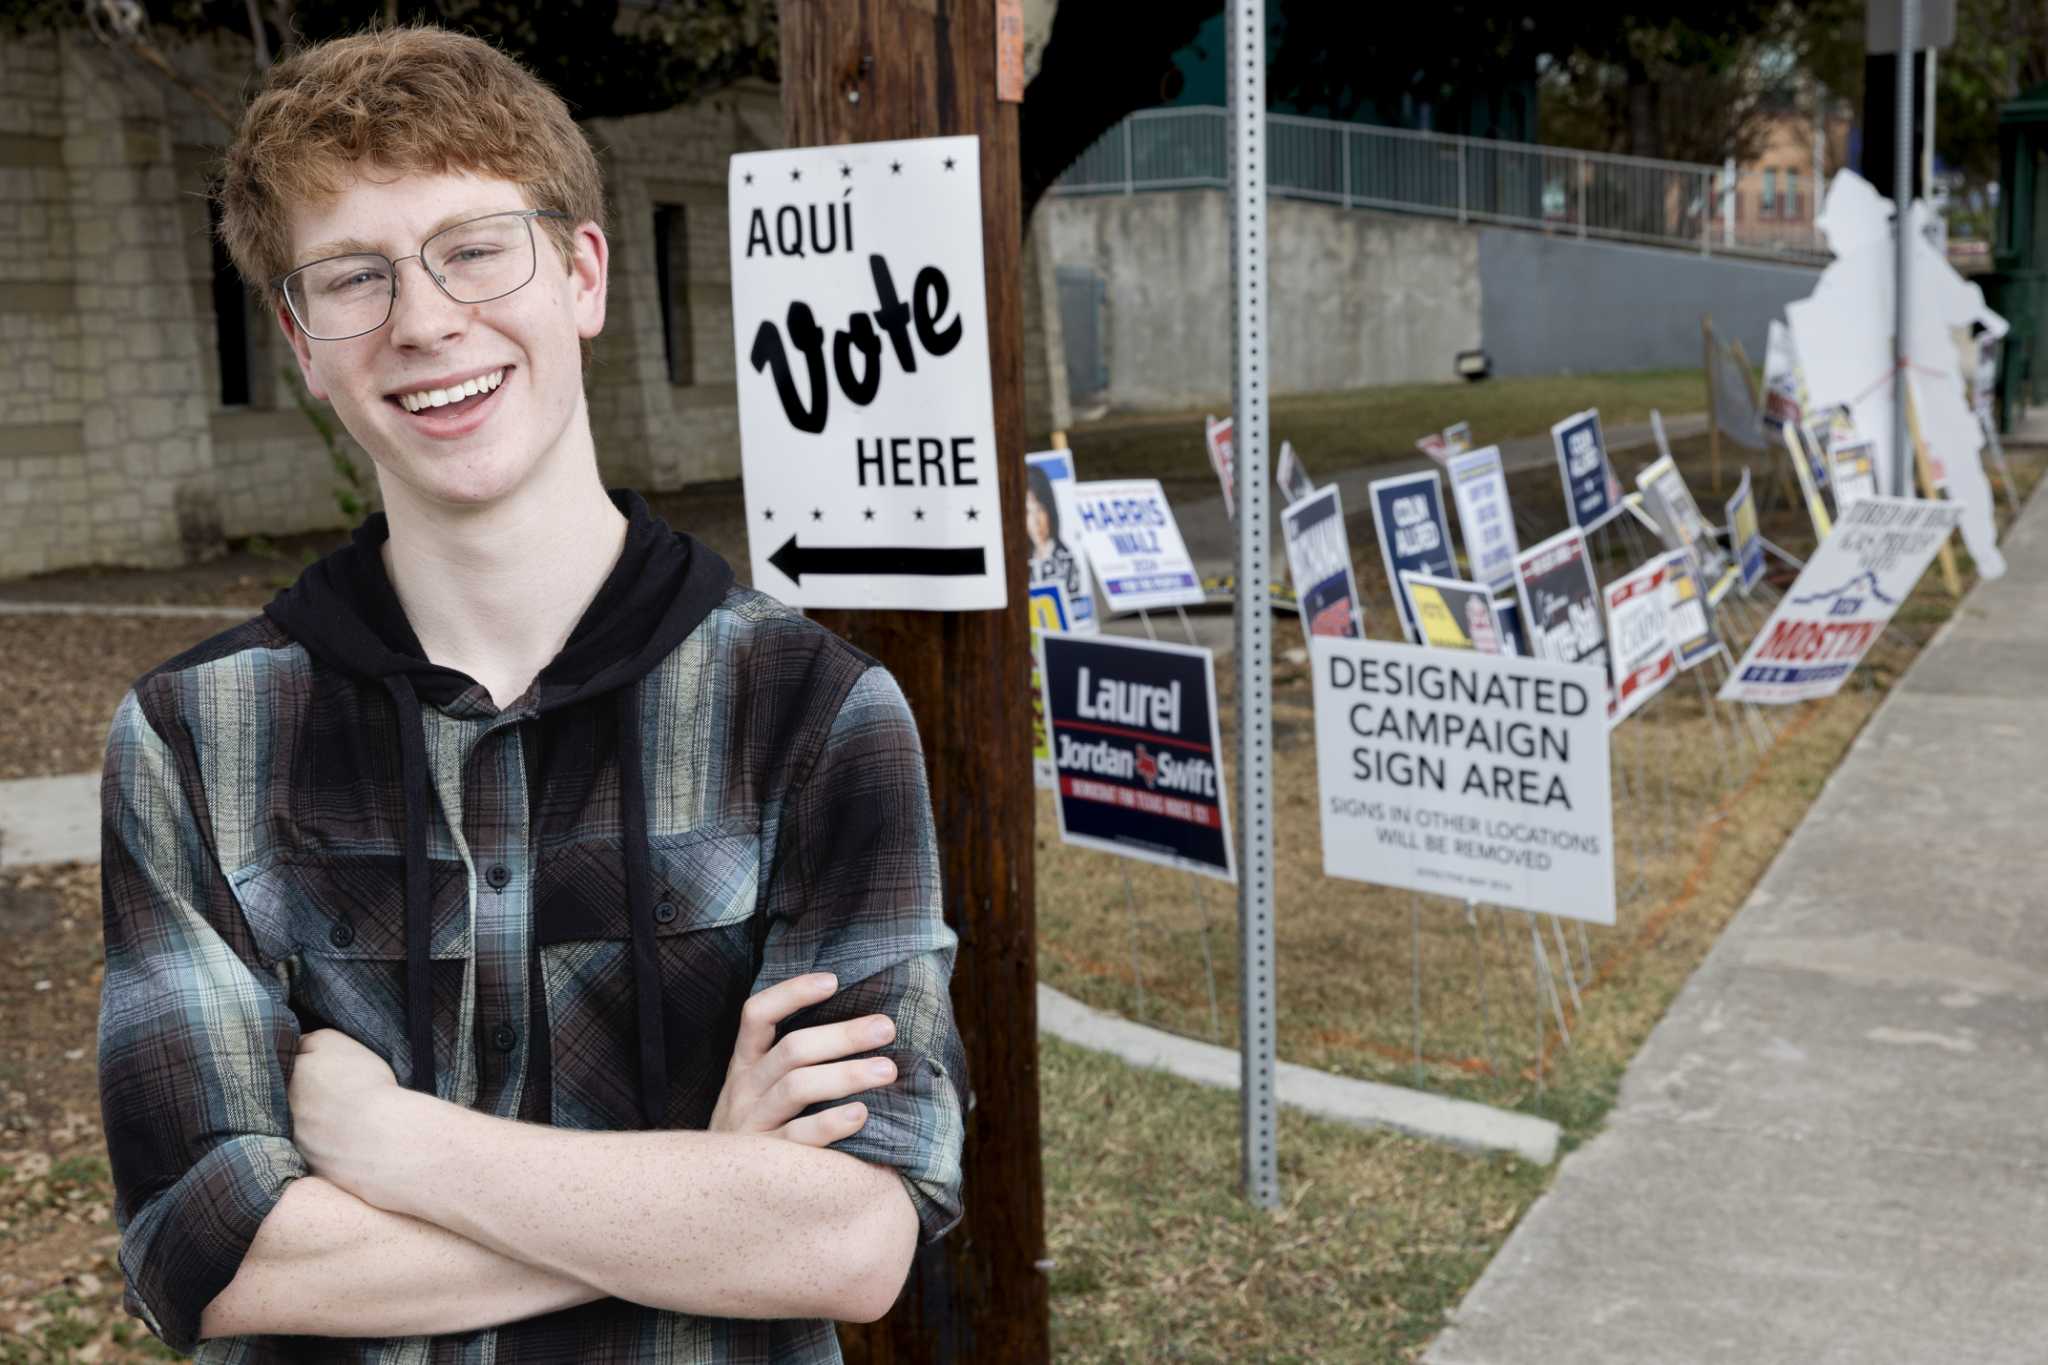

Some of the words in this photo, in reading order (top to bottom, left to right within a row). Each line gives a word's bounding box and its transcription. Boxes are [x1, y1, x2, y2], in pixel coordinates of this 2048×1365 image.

[745, 187, 855, 258] AQUÍ
[750, 253, 963, 434] Vote
[856, 436, 979, 488] HERE
[1077, 497, 1166, 533] HARRIS
[1077, 667, 1181, 733] Laurel
[1330, 656, 1588, 718] DESIGNATED
[1350, 703, 1570, 763] CAMPAIGN
[1058, 734, 1134, 779] Jordan
[1157, 752, 1216, 797] Swift
[1353, 748, 1446, 791] SIGN
[1461, 763, 1573, 811] AREA
[1330, 796, 1385, 822] SIGNS
[1390, 805, 1410, 824] IN
[1415, 808, 1481, 838] OTHER
[1485, 820, 1600, 855] LOCATIONS
[1376, 826, 1420, 851] WILL
[1425, 833, 1447, 855] BE
[1453, 837, 1553, 871] REMOVED
